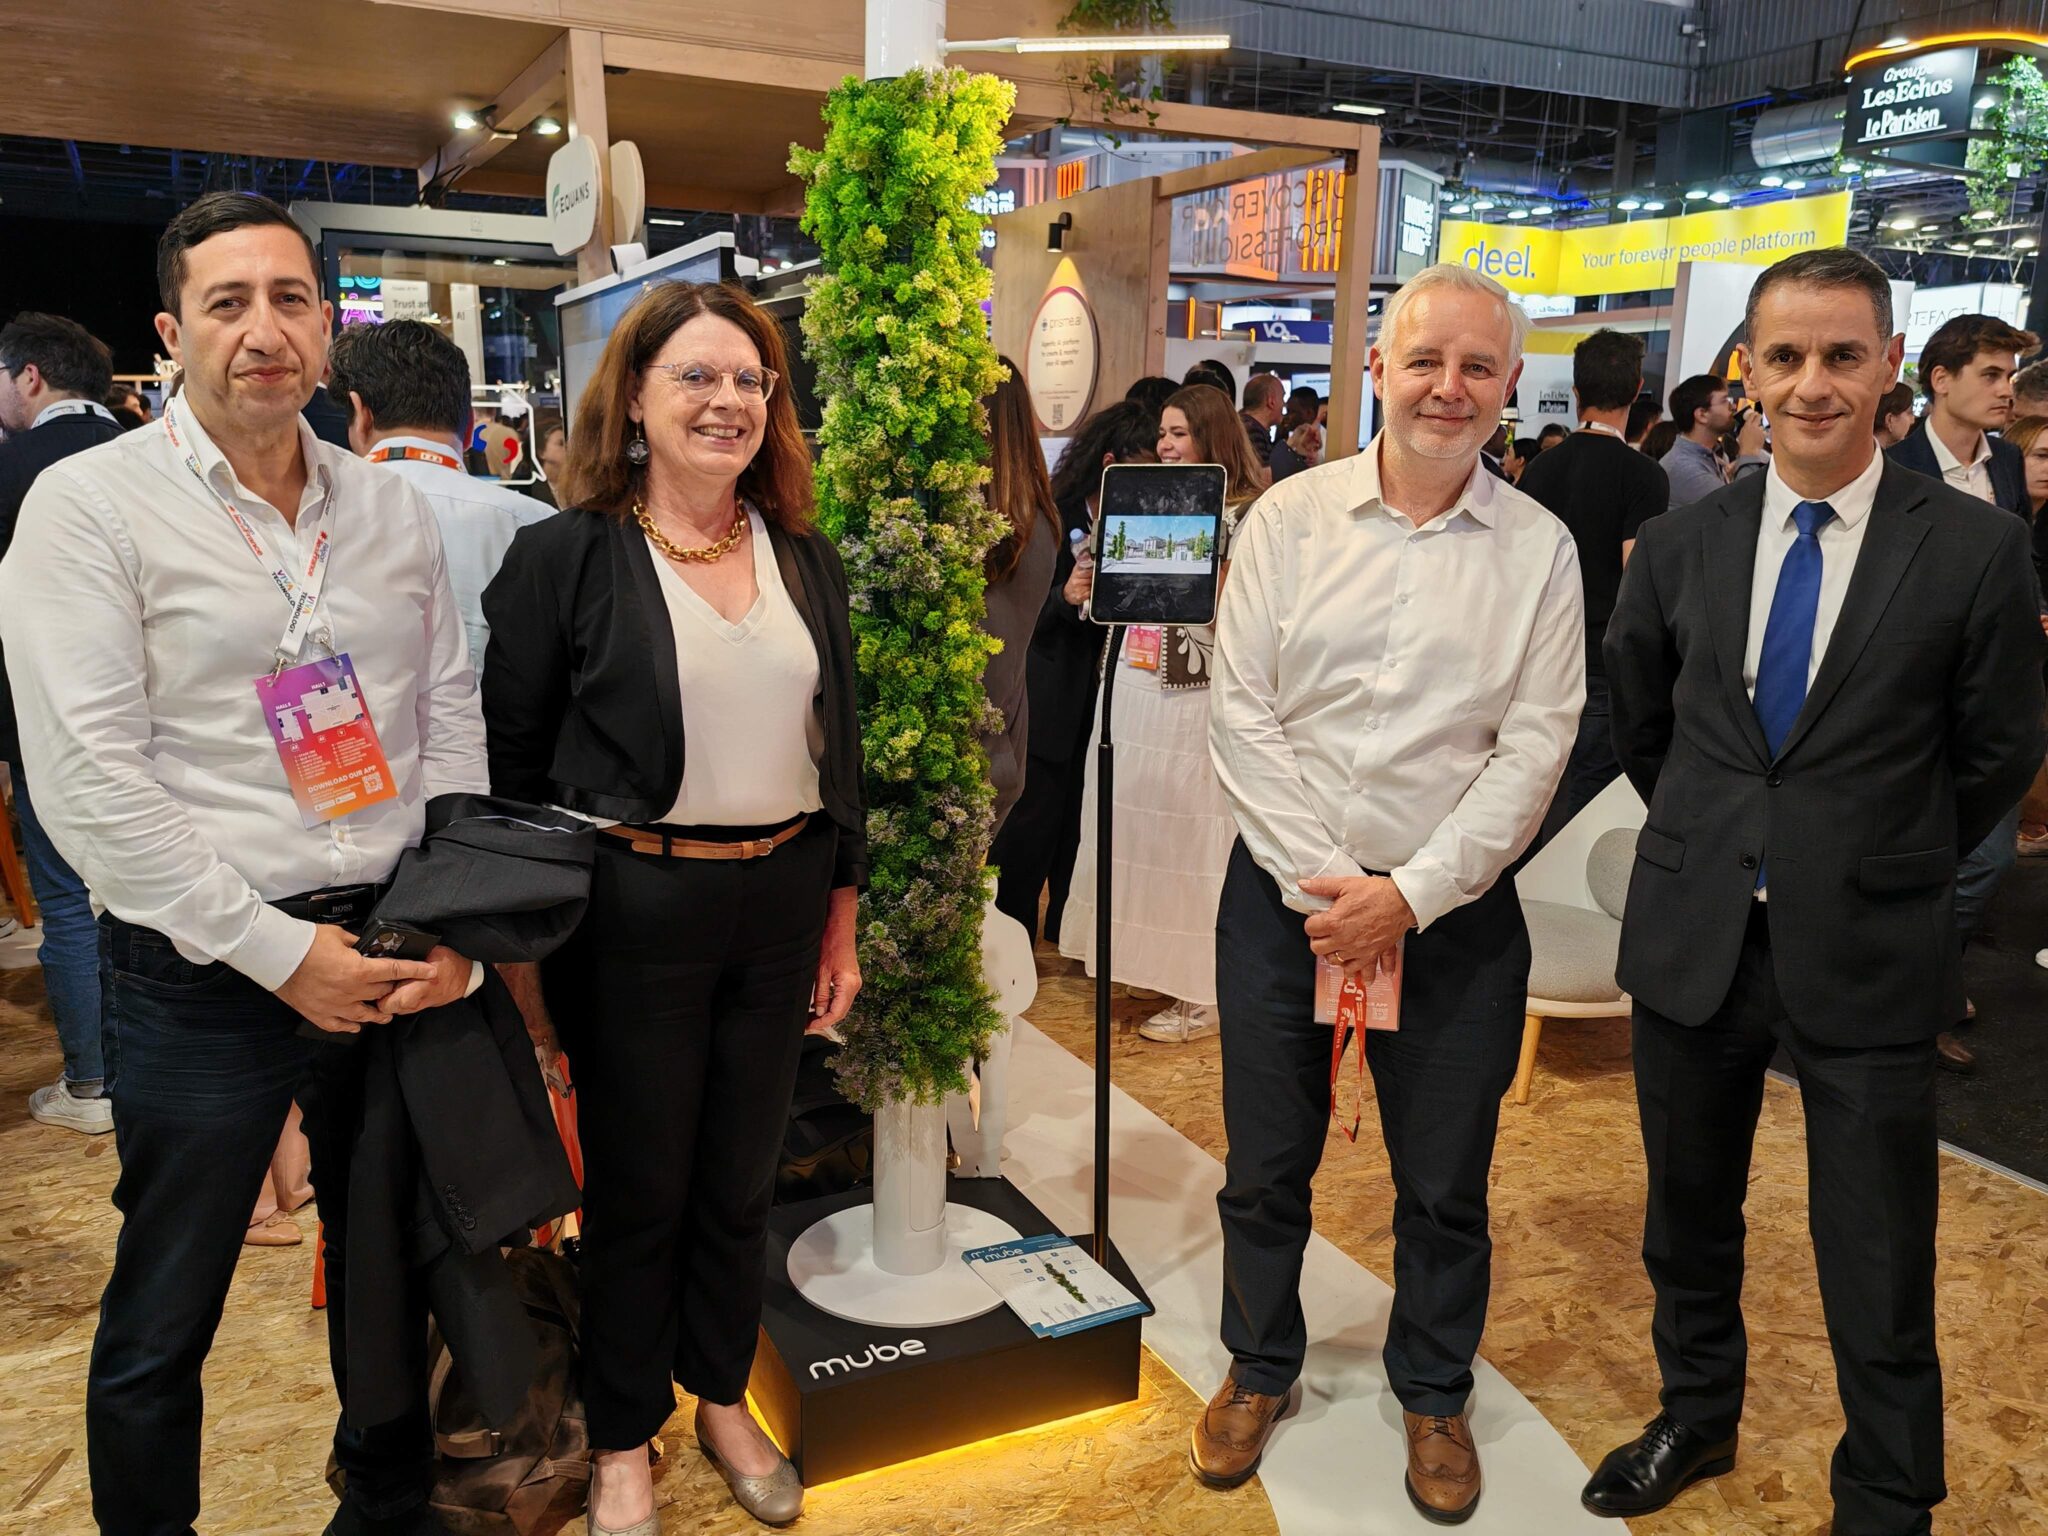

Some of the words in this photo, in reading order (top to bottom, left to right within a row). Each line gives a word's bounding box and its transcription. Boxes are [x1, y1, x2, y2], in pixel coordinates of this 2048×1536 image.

[560, 182, 590, 213] EQUANS
[1464, 241, 1535, 279] deel.
[1582, 251, 1615, 269] Your
[1619, 245, 1676, 265] forever
[1679, 238, 1736, 261] people
[1740, 230, 1816, 256] platform
[272, 571, 297, 609] TECHNOLO
[277, 569, 295, 592] VIVA
[289, 591, 307, 634] TECHNOLOGY
[302, 594, 317, 615] VIVA
[308, 775, 348, 793] DOWNLOAD
[348, 770, 364, 780] OUR
[363, 765, 377, 775] APP
[984, 1247, 1025, 1262] mube
[808, 1339, 927, 1380] mube
